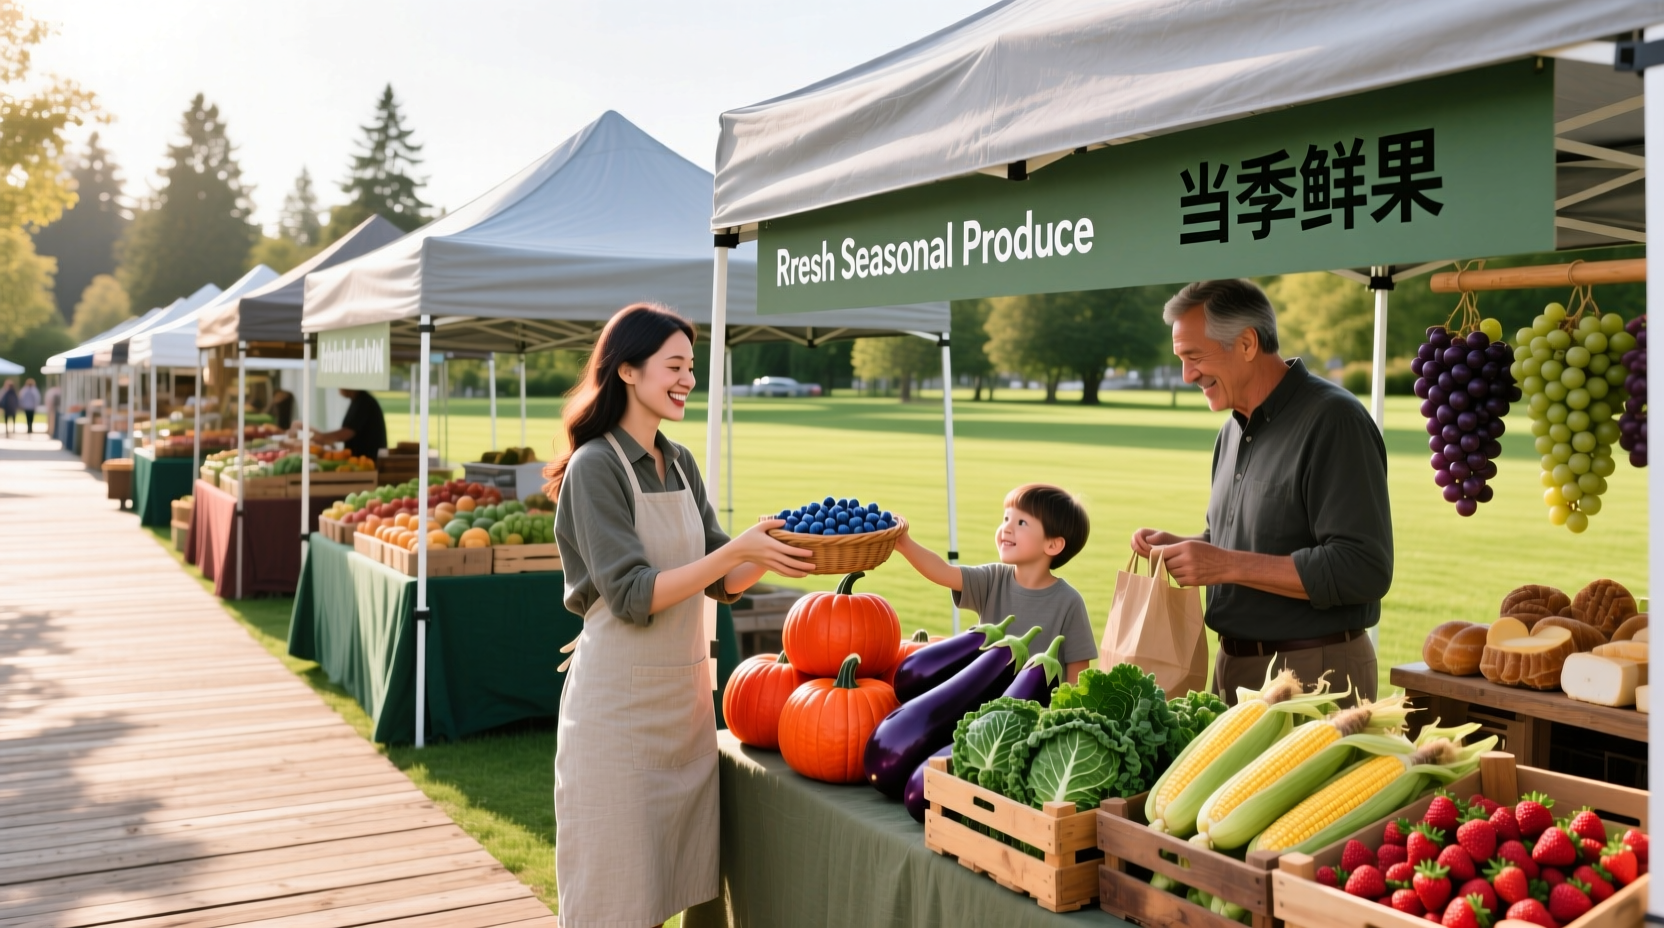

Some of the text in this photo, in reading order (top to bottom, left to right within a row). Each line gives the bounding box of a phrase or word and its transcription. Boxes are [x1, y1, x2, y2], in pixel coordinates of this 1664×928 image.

[1179, 127, 1444, 245] 当季鲜果
[776, 209, 1095, 287] Rresh Seasonal Produce
